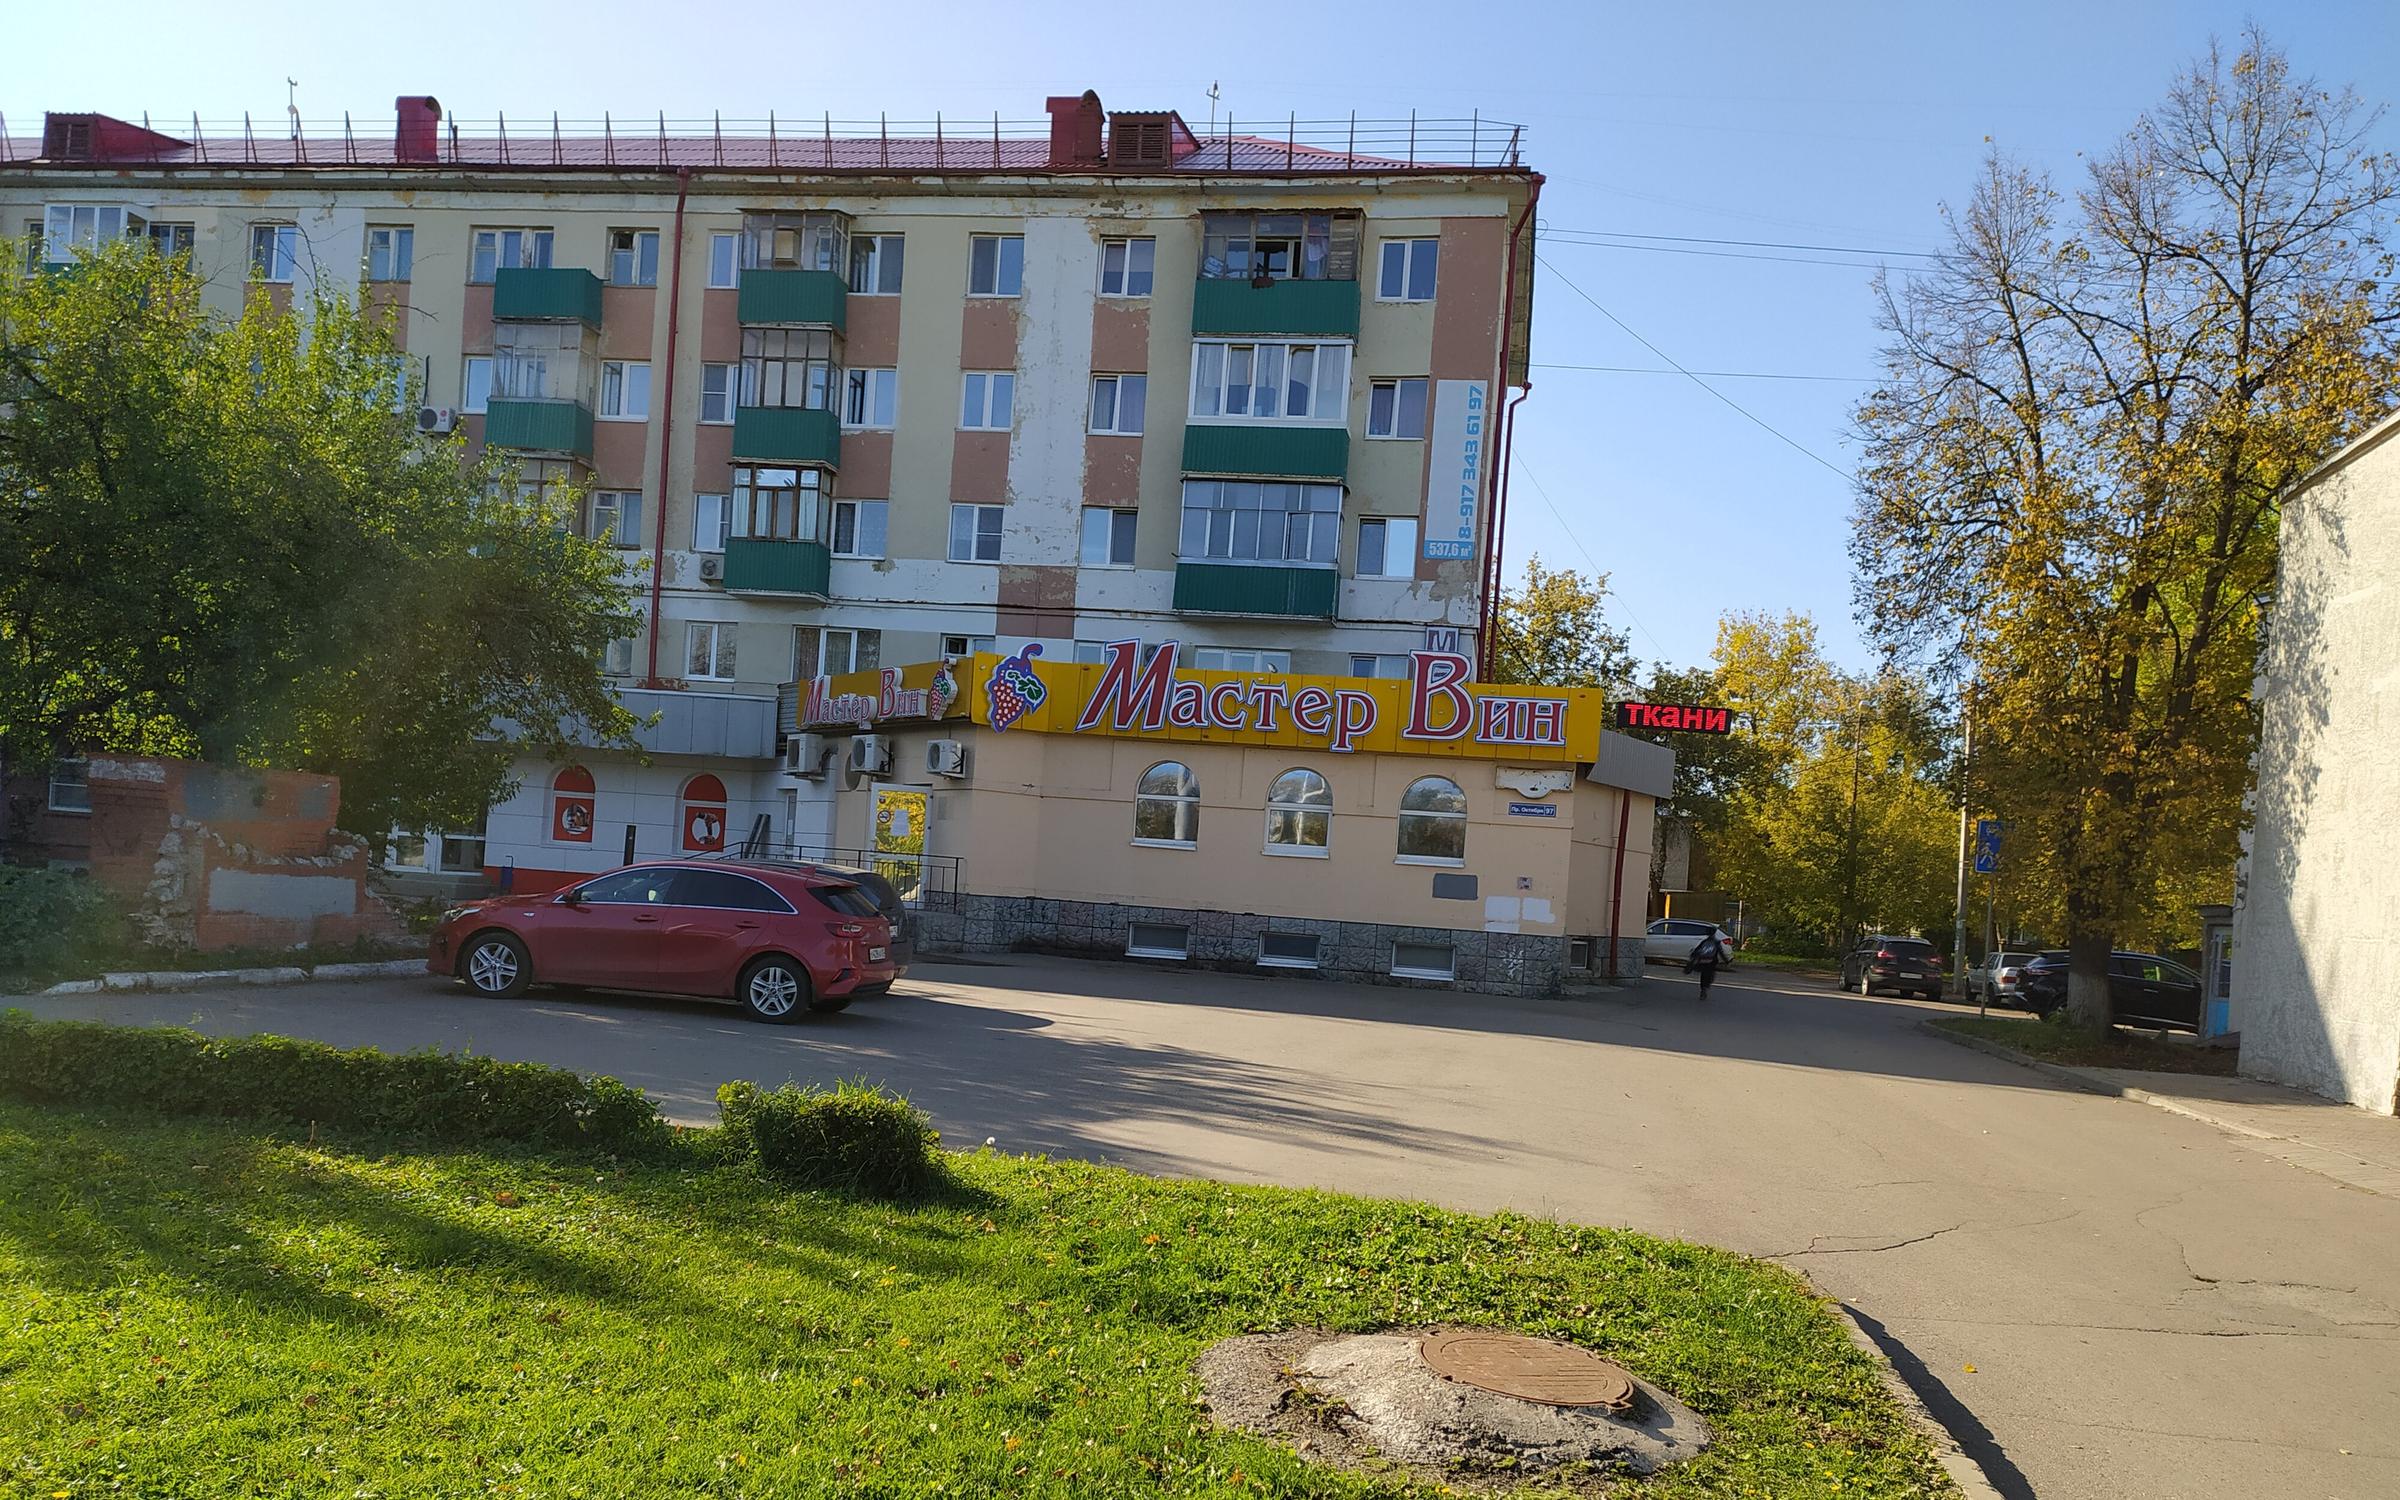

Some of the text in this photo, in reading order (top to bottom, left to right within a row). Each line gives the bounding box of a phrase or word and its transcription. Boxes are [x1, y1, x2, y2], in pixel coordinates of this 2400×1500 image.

[1458, 384, 1483, 539] 8-917 343 61 97
[1429, 542, 1459, 557] 537,6
[802, 666, 924, 730] Мастер Вин
[1074, 637, 1569, 752] Мастер Вин
